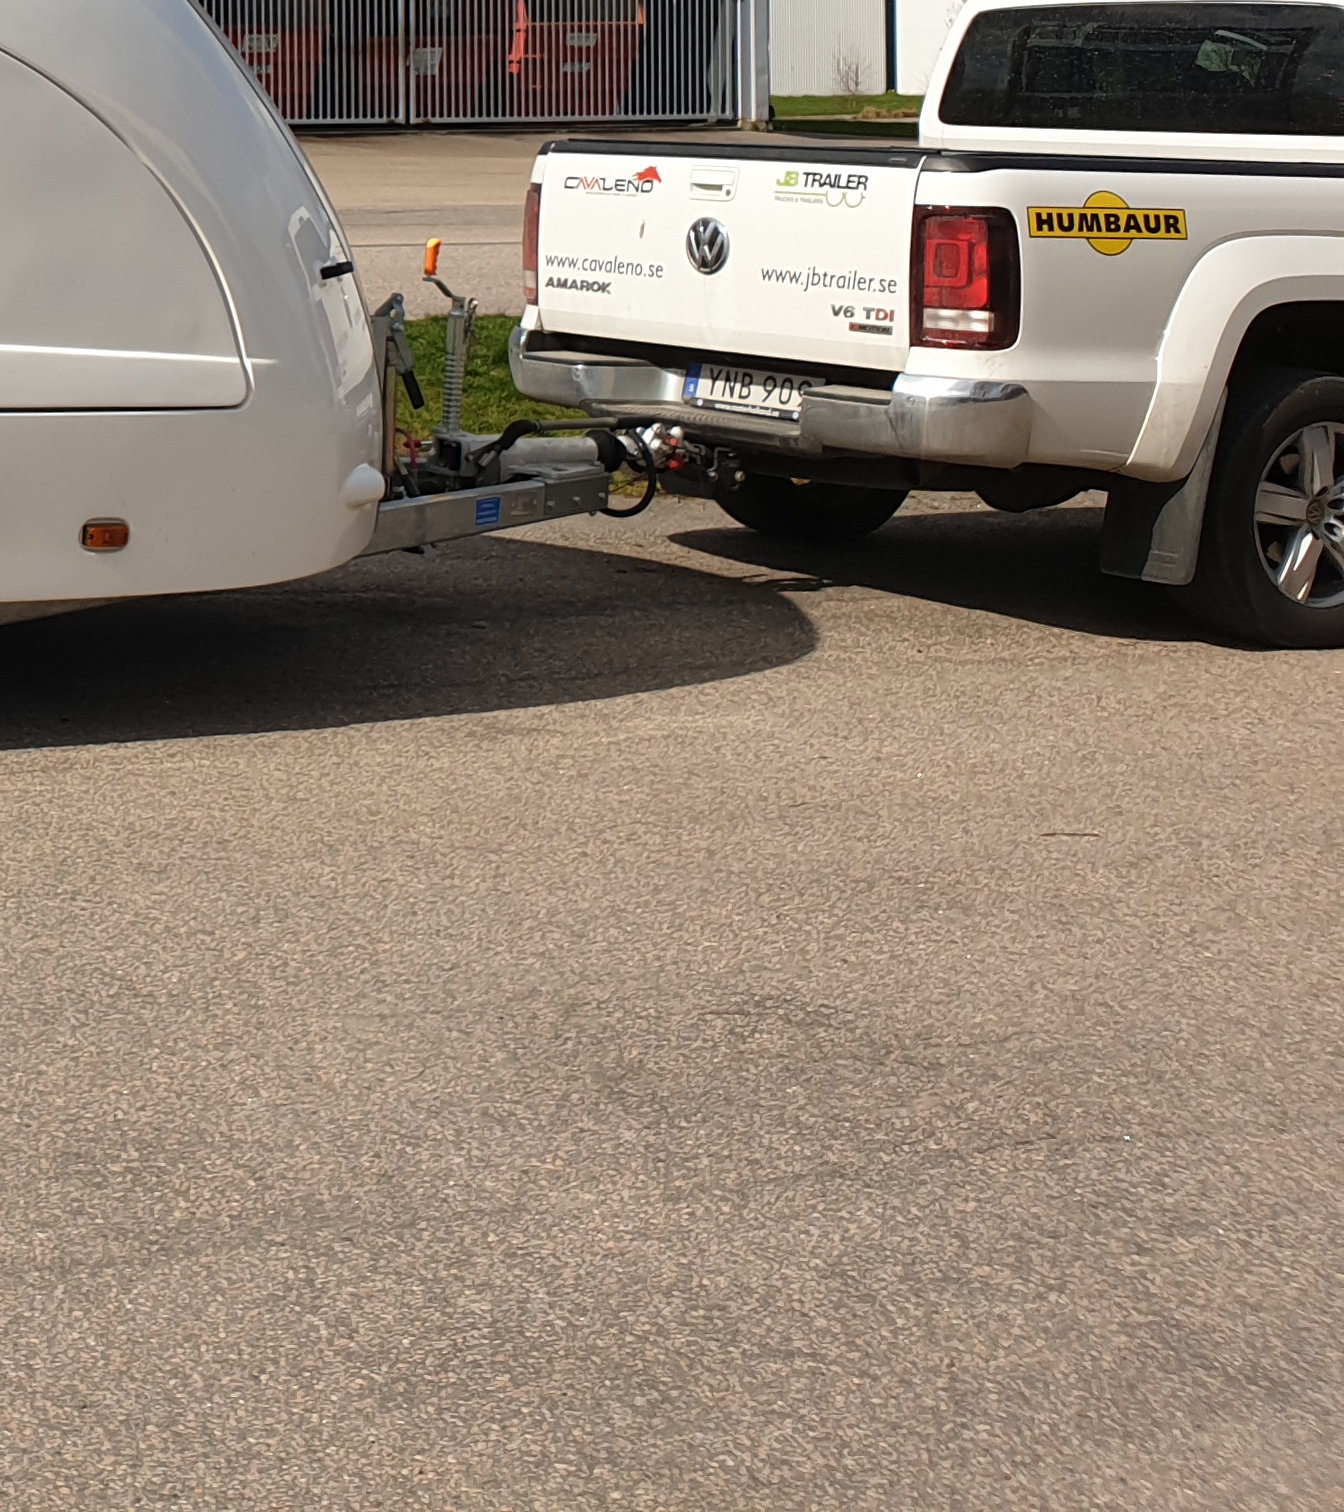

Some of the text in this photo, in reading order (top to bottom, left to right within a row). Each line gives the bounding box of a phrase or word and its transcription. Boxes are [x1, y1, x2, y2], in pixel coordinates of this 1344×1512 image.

[564, 176, 654, 193] CAVALENO
[802, 172, 869, 191] TRAILER
[1035, 212, 1182, 234] HUMBAUR
[545, 254, 664, 278] www.cavaleno.se
[545, 276, 612, 294] AMAROK
[761, 266, 898, 294] www.jbtrailer.se
[830, 304, 895, 322] V6 TDI
[709, 367, 753, 399] YNB
